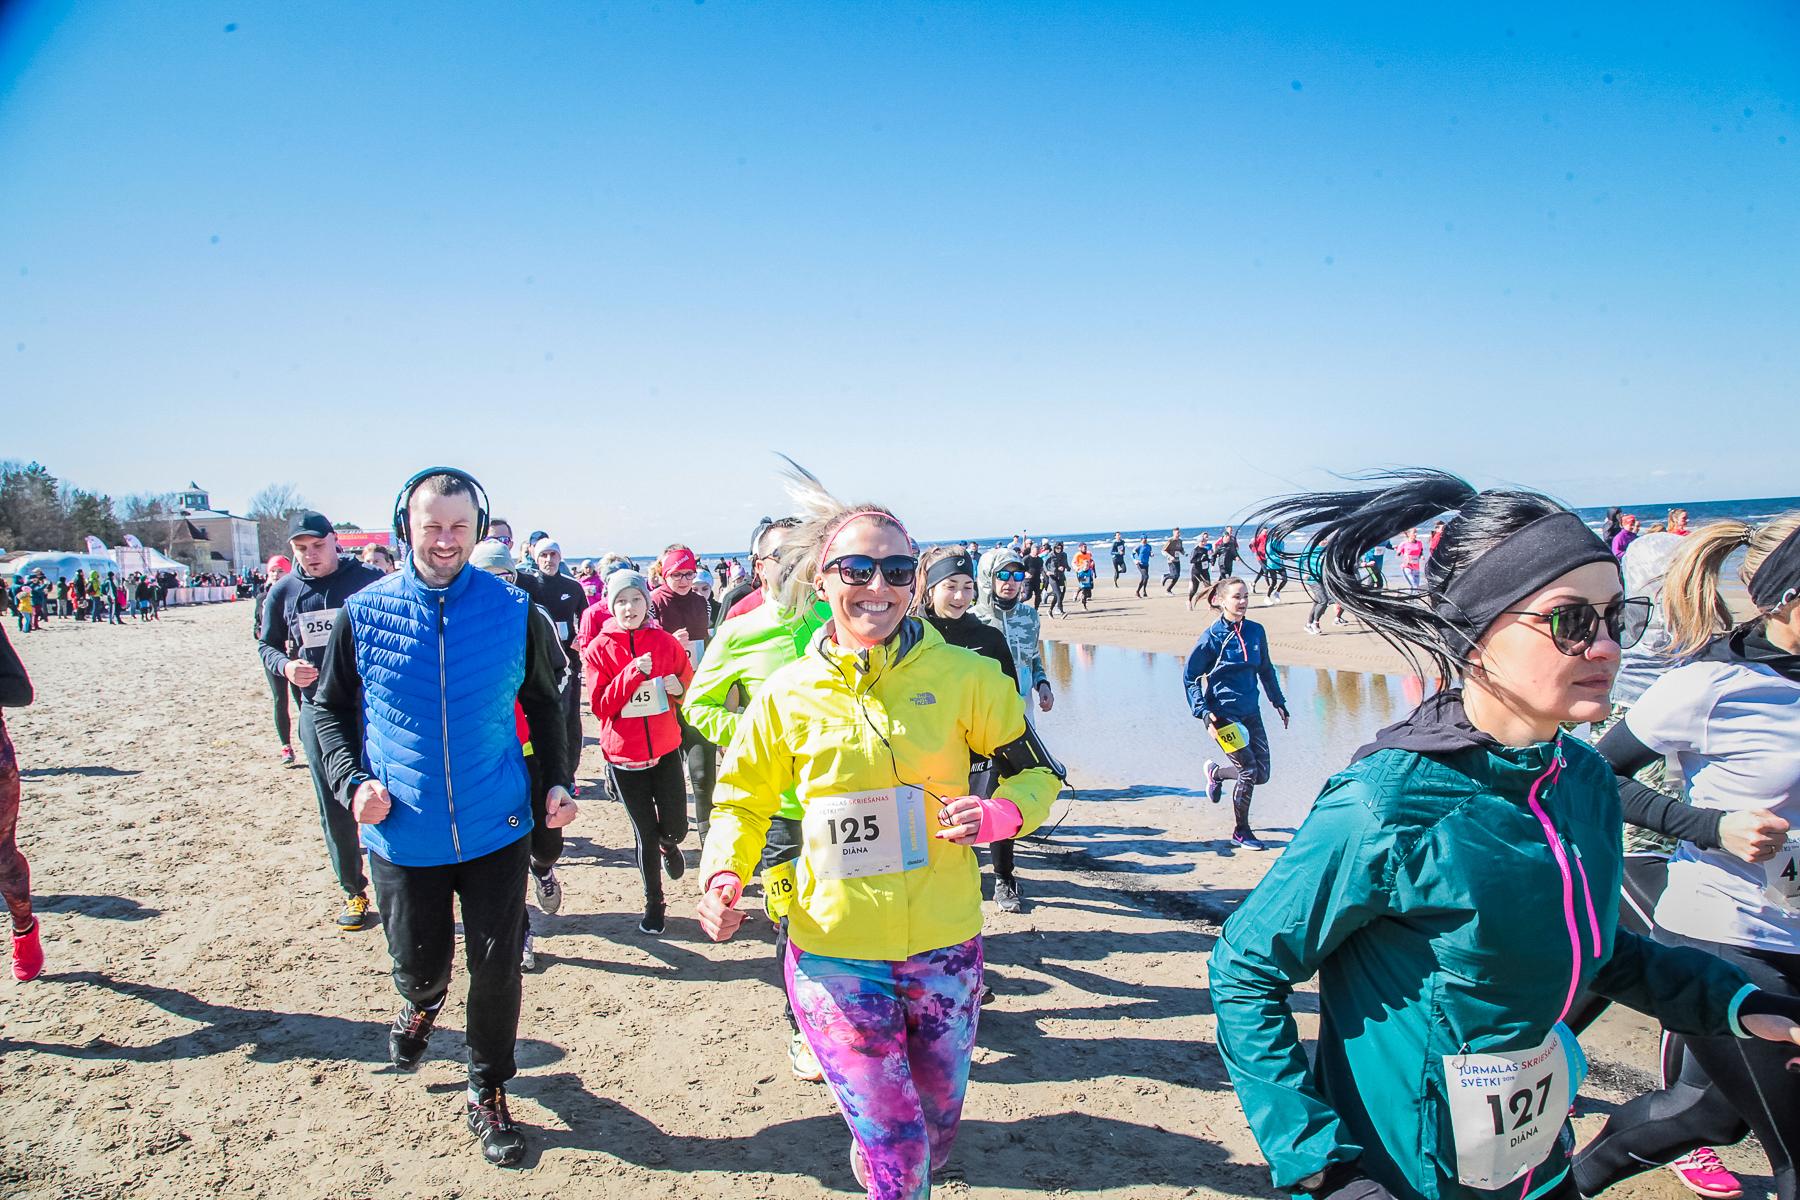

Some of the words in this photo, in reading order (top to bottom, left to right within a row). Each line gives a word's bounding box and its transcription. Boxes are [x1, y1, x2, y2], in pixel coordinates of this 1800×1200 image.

[307, 620, 333, 633] 256
[1221, 732, 1237, 743] 281
[971, 761, 986, 772] NIKE
[828, 815, 880, 845] 125
[1780, 856, 1800, 881] 4
[1459, 1063, 1519, 1076] JŪRMALAS
[1461, 1076, 1501, 1088] SVĒTKI
[1486, 1072, 1553, 1135] 127
[1510, 1126, 1539, 1148] DIĀNA
